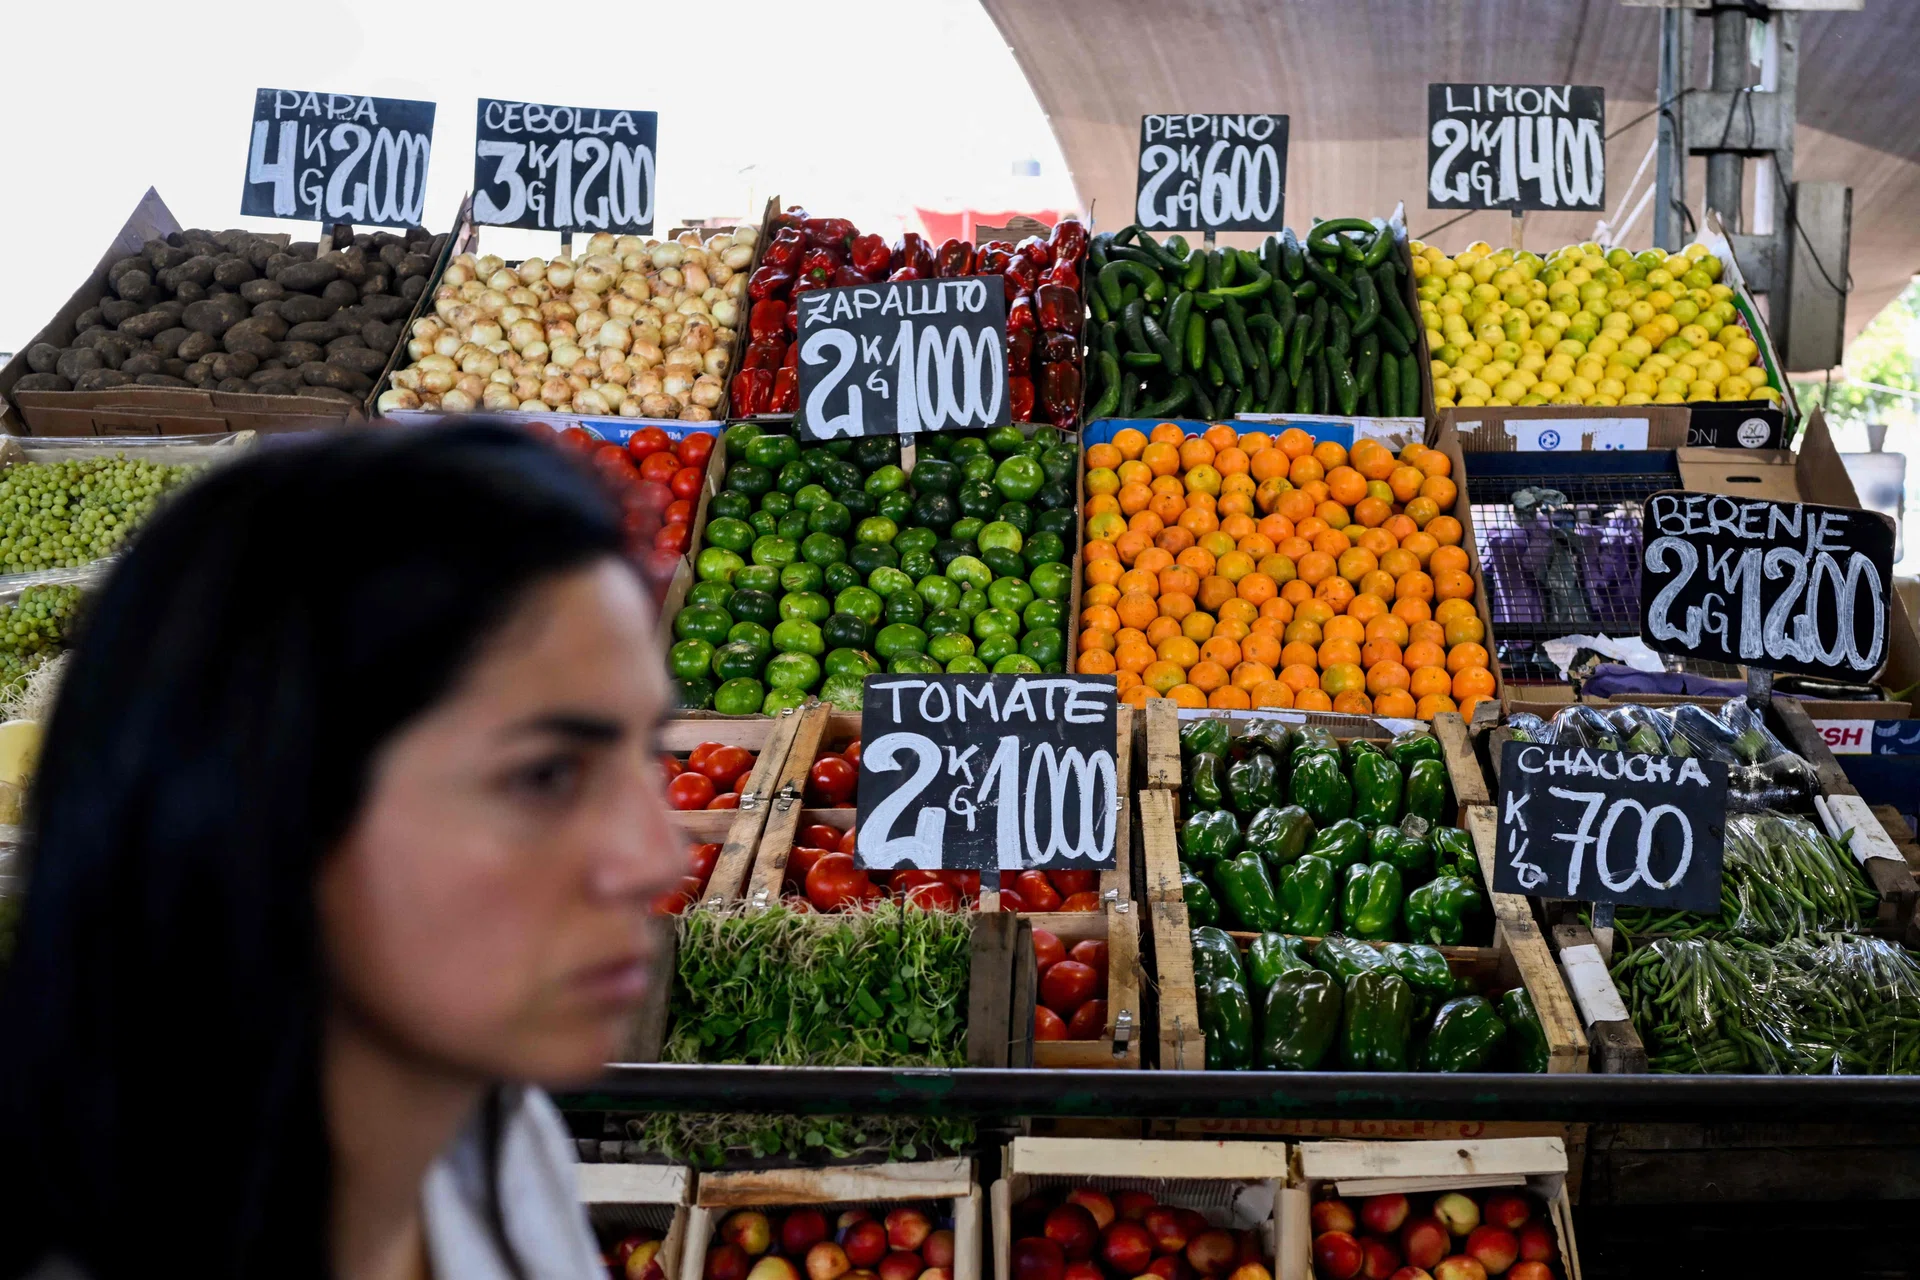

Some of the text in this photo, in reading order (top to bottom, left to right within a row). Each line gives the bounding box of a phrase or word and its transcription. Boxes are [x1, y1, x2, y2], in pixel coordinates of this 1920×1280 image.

[274, 89, 379, 125] PAPA
[485, 101, 638, 135] CEBOLLA
[1144, 114, 1275, 142] PEPINO
[1446, 85, 1571, 115] LIMON
[249, 120, 298, 217] 4
[326, 122, 430, 226] 2000
[473, 139, 527, 225] 3
[545, 137, 655, 229] 1200
[1137, 144, 1179, 228] 2
[1200, 140, 1280, 226] 600
[1430, 118, 1469, 202] 2
[1489, 115, 1604, 207] 1400
[800, 328, 864, 440] 2
[886, 320, 1004, 433] 1000
[1651, 494, 1851, 563] BERENJE
[1645, 536, 1702, 649] 2
[1728, 546, 1884, 671] 1200
[870, 677, 1117, 724] TOMATE
[1816, 727, 1864, 746] SH
[857, 732, 946, 870] 2
[977, 735, 1117, 870] 1000
[1517, 746, 1711, 787] CHAUCHA
[1548, 786, 1693, 896] 700
